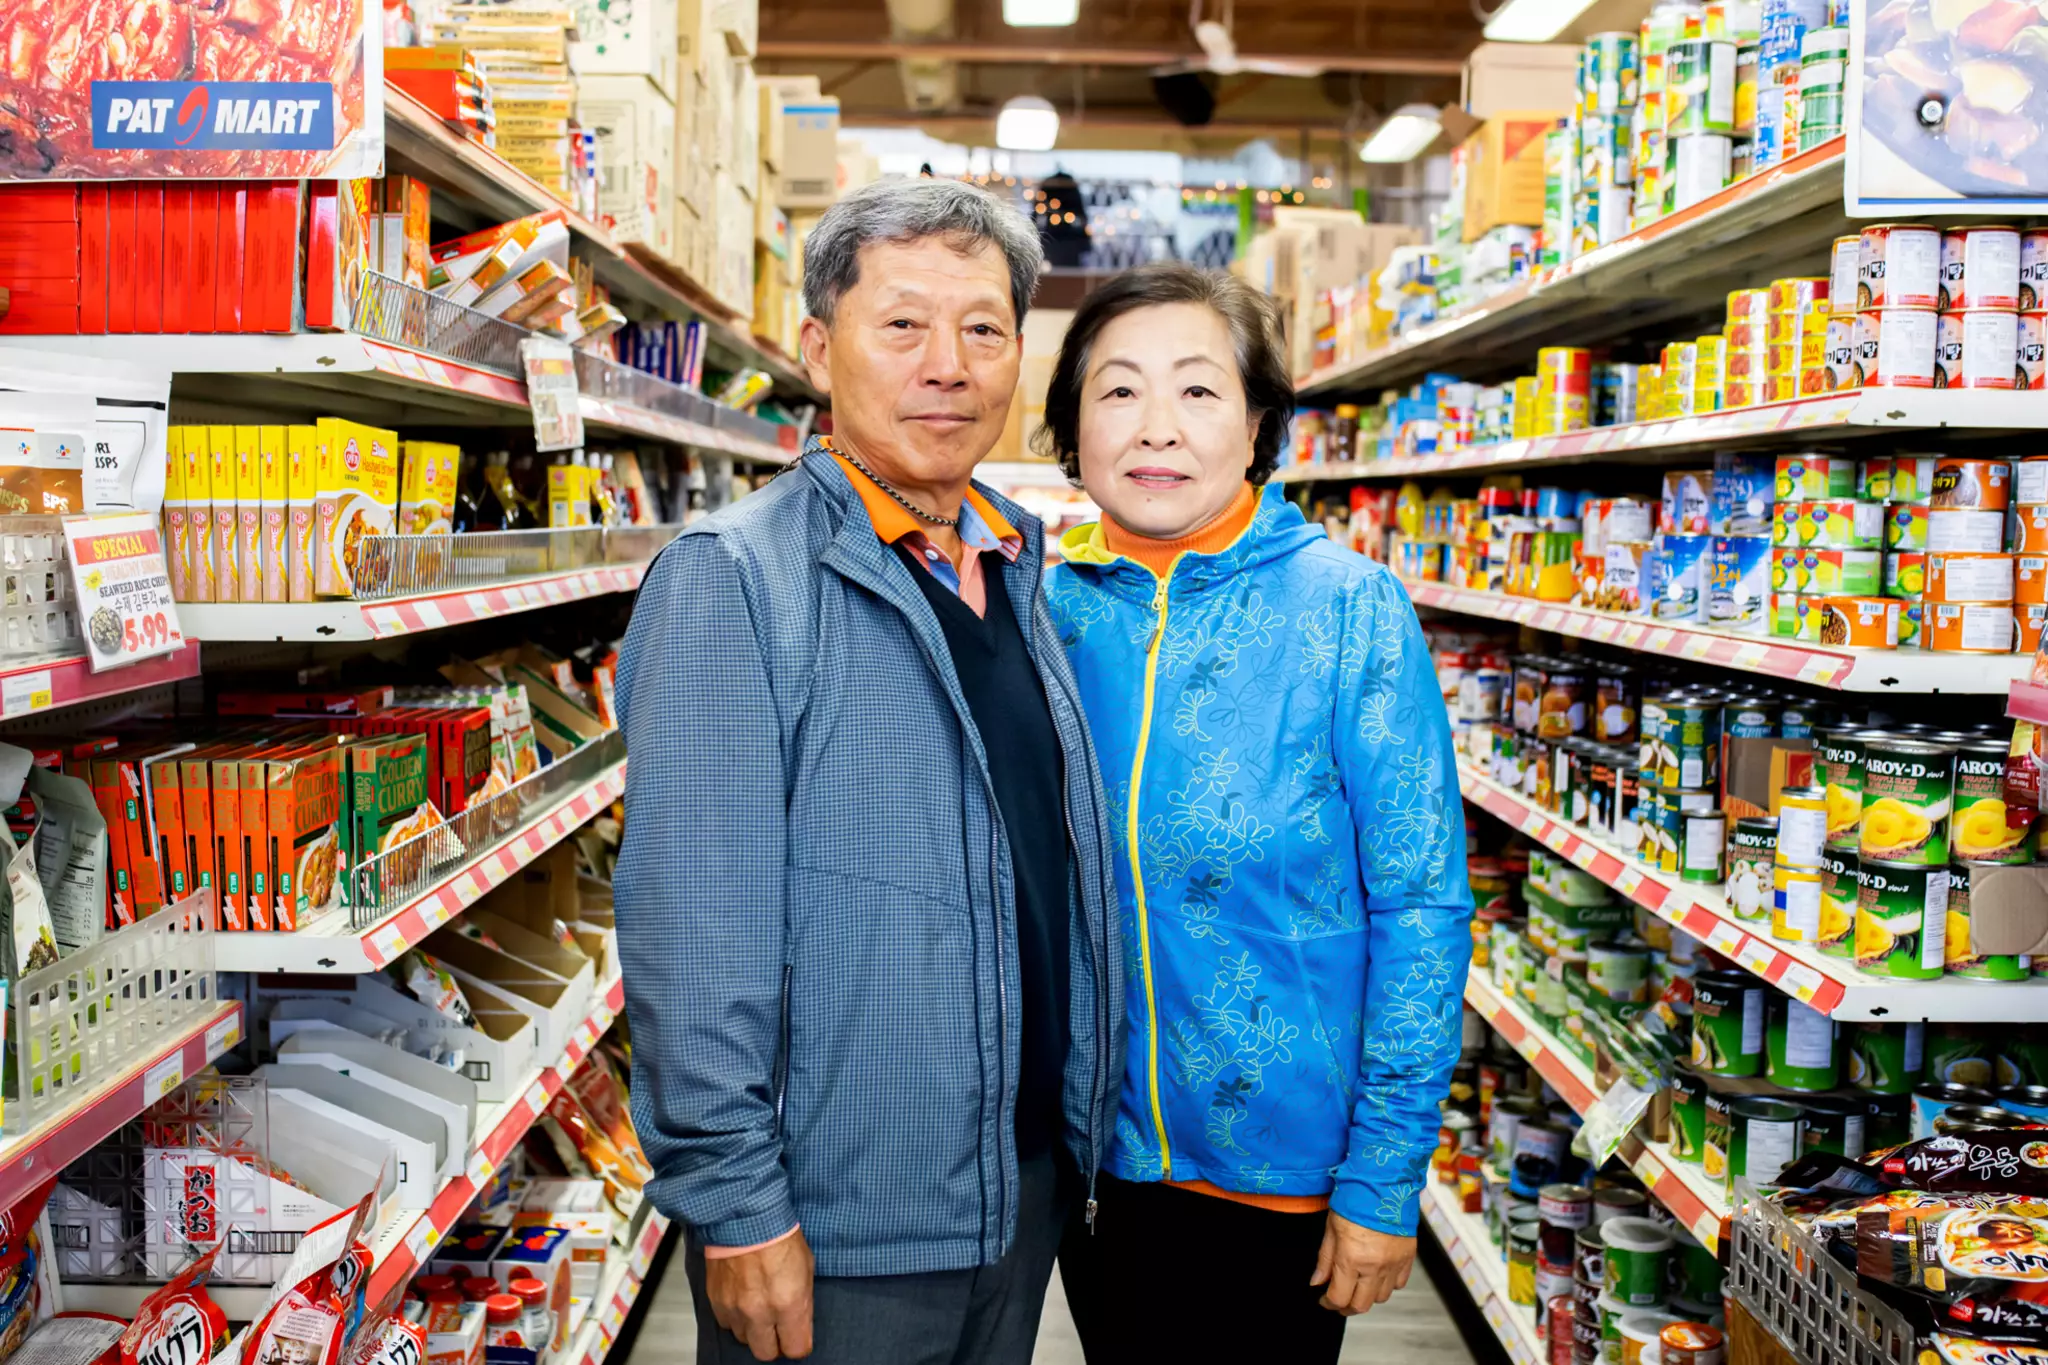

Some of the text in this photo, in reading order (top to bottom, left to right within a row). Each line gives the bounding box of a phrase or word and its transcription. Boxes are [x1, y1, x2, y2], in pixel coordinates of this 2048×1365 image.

[106, 98, 320, 135] PAT MART
[95, 442, 111, 454] RI
[92, 535, 147, 560] SPECIAL
[99, 581, 134, 598] SEAWEED
[135, 578, 151, 591] RICE
[133, 590, 159, 612] 김부각
[379, 755, 422, 785] GOLDEN
[1866, 758, 1926, 778] AROY-D
[295, 771, 334, 803] GOLDEN
[378, 776, 425, 813] CURRY
[127, 801, 136, 820] MILD
[294, 792, 336, 833] CURRY
[118, 870, 127, 890] MILD
[175, 873, 184, 892] MILD
[202, 873, 210, 888] MIL
[229, 874, 237, 893] MILD
[282, 874, 290, 893] MILD
[1968, 1144, 2020, 1181] 우동
[189, 1169, 212, 1233] かつお
